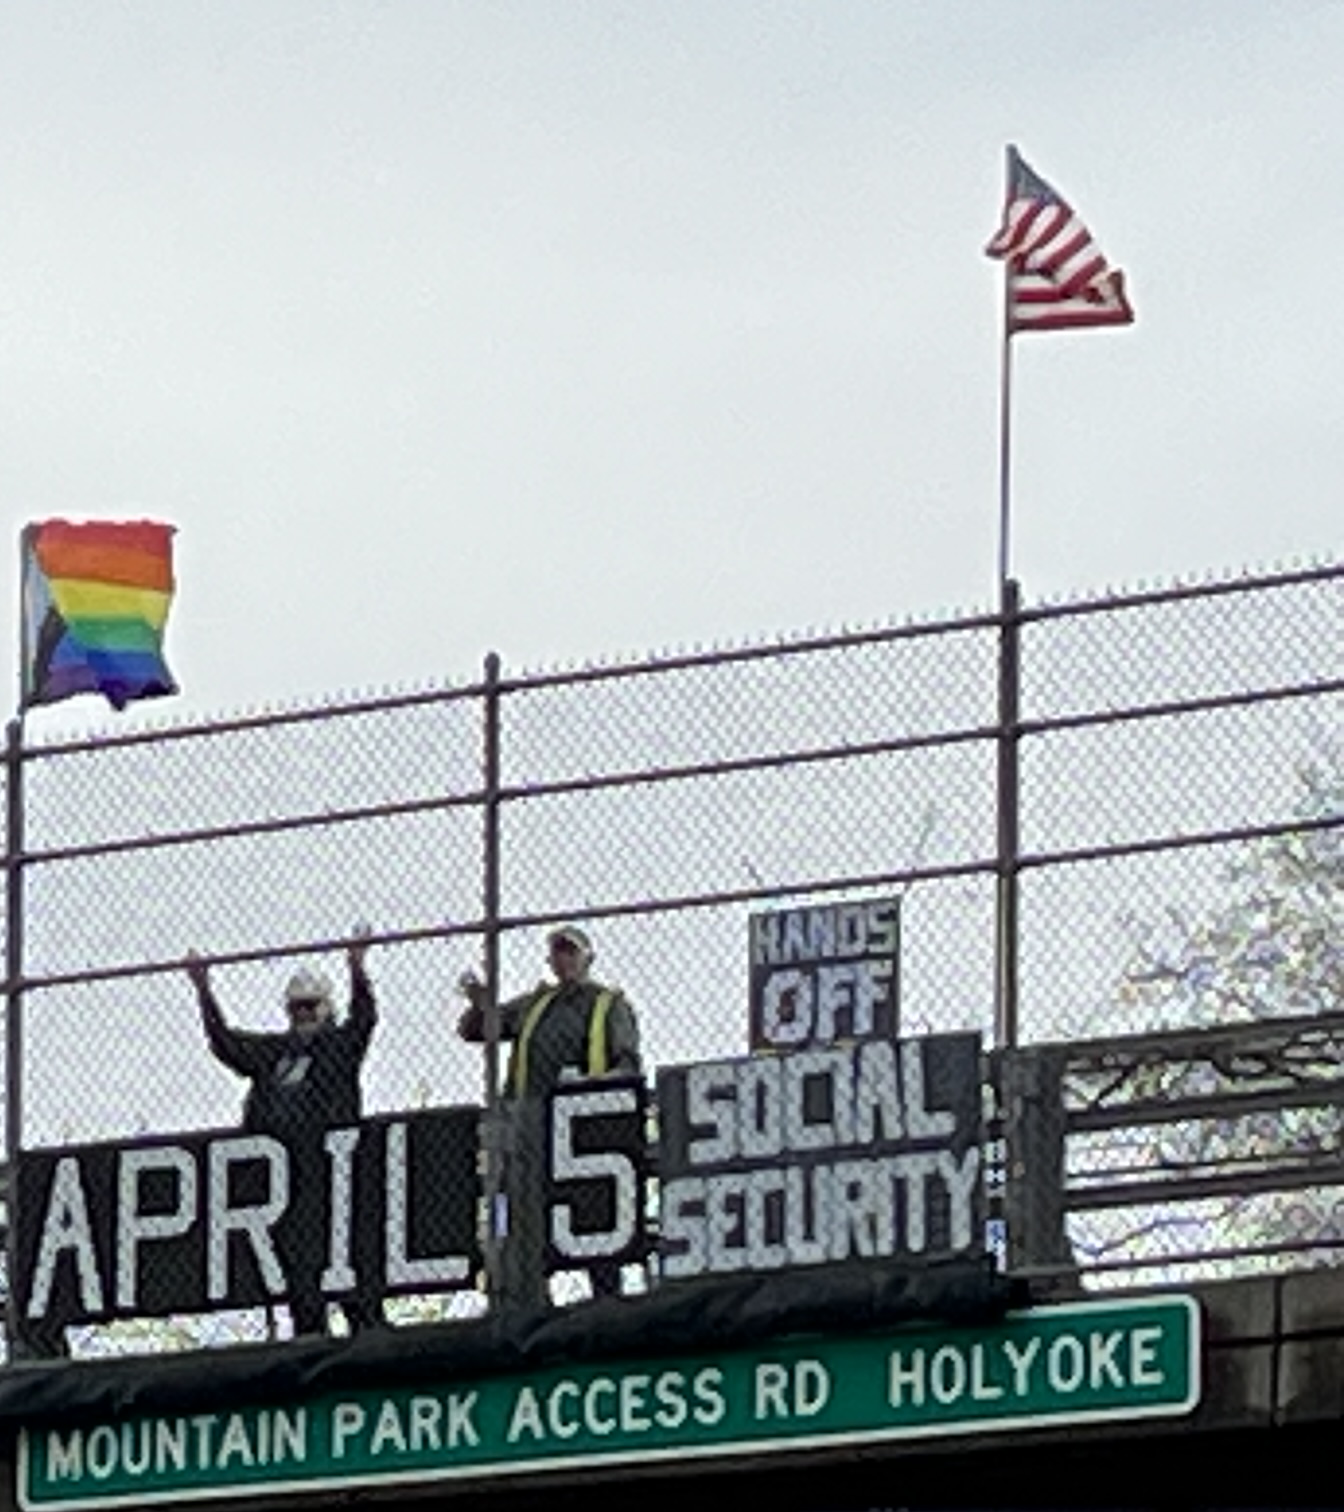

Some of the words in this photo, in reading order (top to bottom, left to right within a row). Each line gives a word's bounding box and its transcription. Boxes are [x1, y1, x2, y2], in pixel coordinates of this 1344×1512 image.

[754, 903, 898, 965] HANDS
[763, 959, 894, 1043] OFF
[686, 1040, 956, 1164] SOCIAL
[27, 1121, 470, 1319] APRIL
[549, 1089, 638, 1258] 5
[658, 1145, 982, 1278] SECURITY
[45, 1406, 308, 1483] MOUNTAIN
[331, 1390, 481, 1459] PARK
[507, 1366, 725, 1443] ACCESS
[753, 1359, 832, 1420] RD
[887, 1325, 1166, 1408] HOLYOKE
